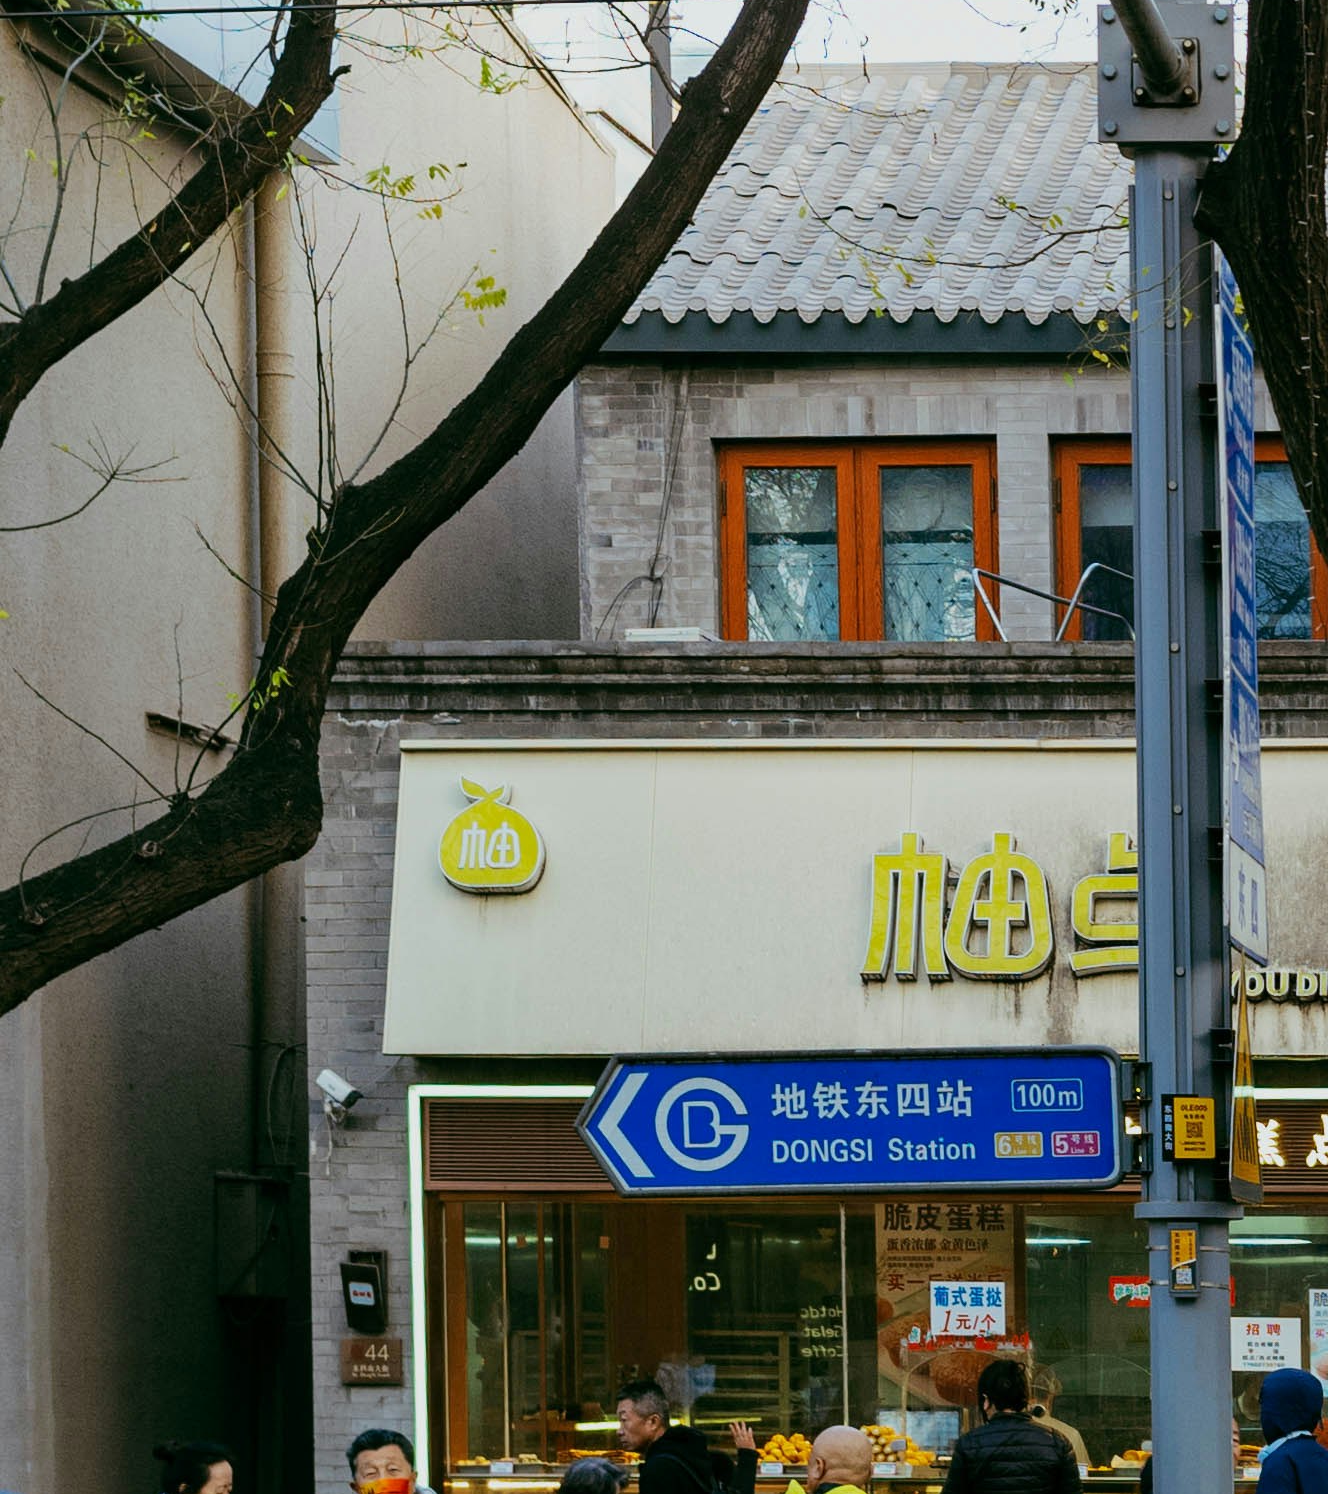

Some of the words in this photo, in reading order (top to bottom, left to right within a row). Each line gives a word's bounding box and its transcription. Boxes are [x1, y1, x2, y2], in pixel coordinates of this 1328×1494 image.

[458, 821, 521, 870] 柚
[771, 1080, 973, 1119] 地铁东四站
[1017, 1083, 1078, 1107] 100m
[772, 1138, 873, 1163] DONGSI
[888, 1137, 976, 1162] Station
[884, 1203, 1005, 1231] 脆皮蛋糕
[934, 1286, 1002, 1307] 葡式蛋挞
[1246, 1323, 1281, 1336] 招聘
[364, 1343, 390, 1361] 44
